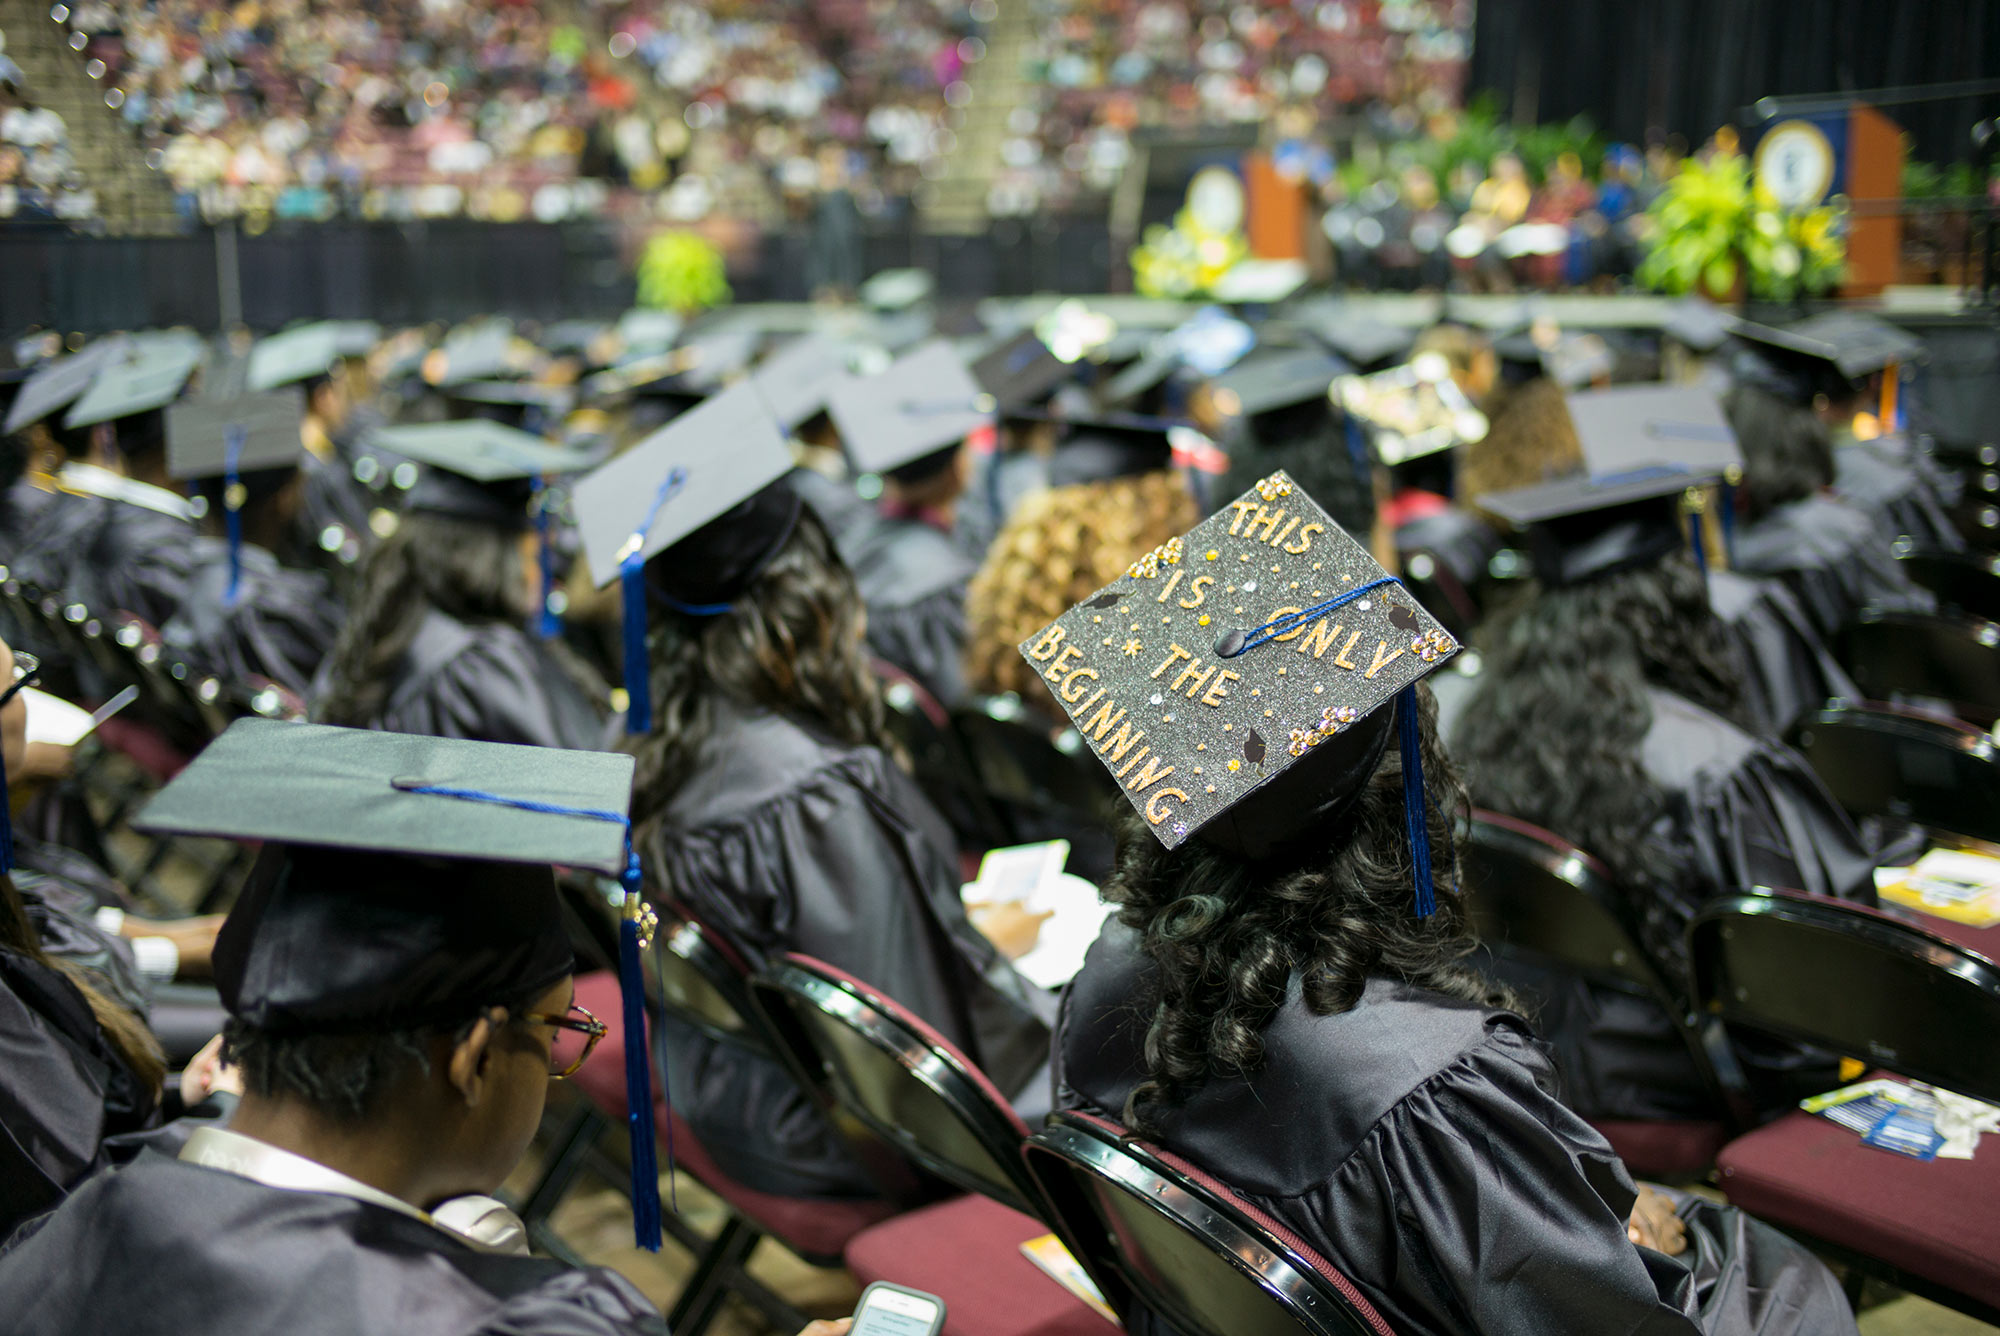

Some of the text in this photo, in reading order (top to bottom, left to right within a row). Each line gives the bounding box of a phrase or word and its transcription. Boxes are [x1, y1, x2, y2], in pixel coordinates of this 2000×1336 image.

[1228, 502, 1323, 554] THIS
[1158, 570, 1214, 609] IS
[1265, 606, 1404, 679] ONLY
[1151, 643, 1240, 707] THE
[1029, 625, 1187, 824] BEGINNING
